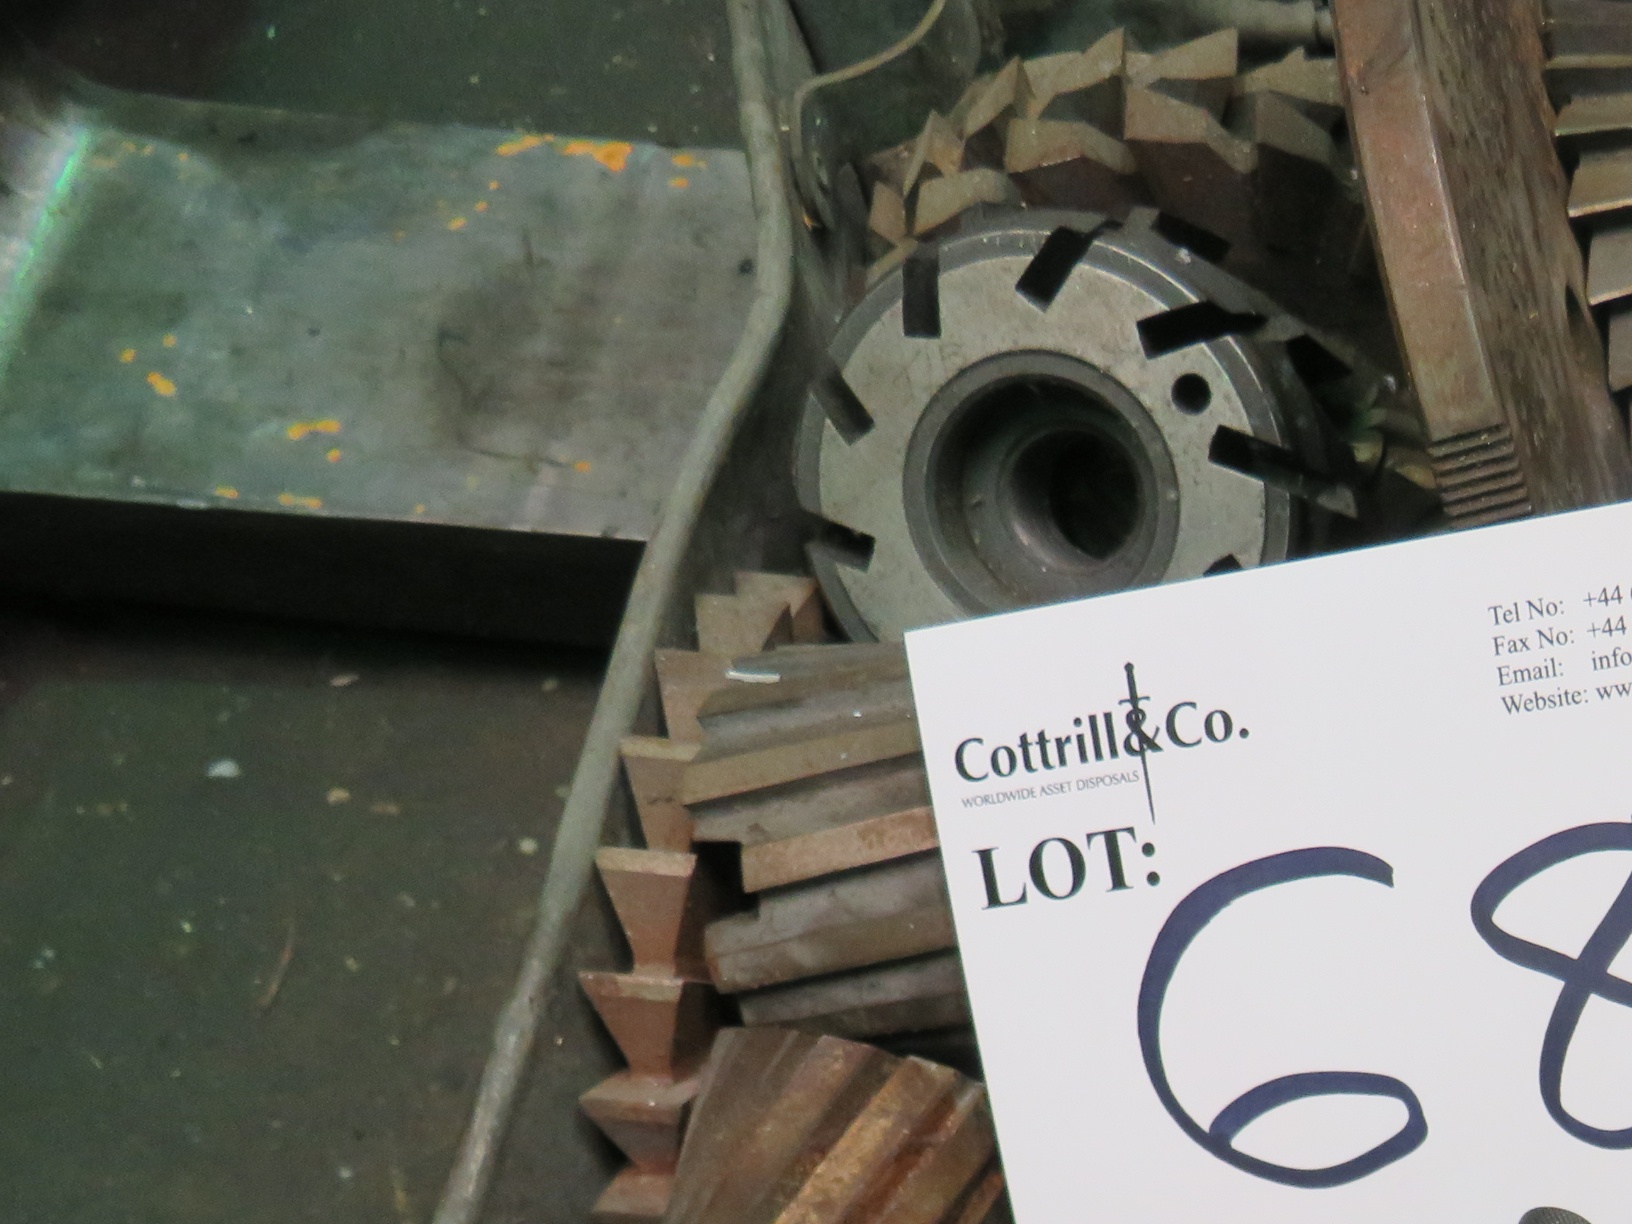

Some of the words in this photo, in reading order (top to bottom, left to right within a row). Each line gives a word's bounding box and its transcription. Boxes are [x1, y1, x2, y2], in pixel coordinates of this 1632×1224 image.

[1488, 602, 1520, 627] Tel
[1528, 598, 1565, 620] No:
[1583, 584, 1623, 607] +44
[1493, 633, 1532, 656] Fax
[1537, 627, 1575, 650] No:
[1586, 615, 1627, 639] +44
[1497, 656, 1564, 687] Email:
[1501, 686, 1589, 716] Website:
[954, 701, 1250, 782] Cottrill&Co.
[961, 786, 1037, 809] WORLDWIDE
[1040, 780, 1071, 798] ASSET
[1076, 769, 1140, 792] DISPOSALS
[972, 826, 1161, 911] LOT:
